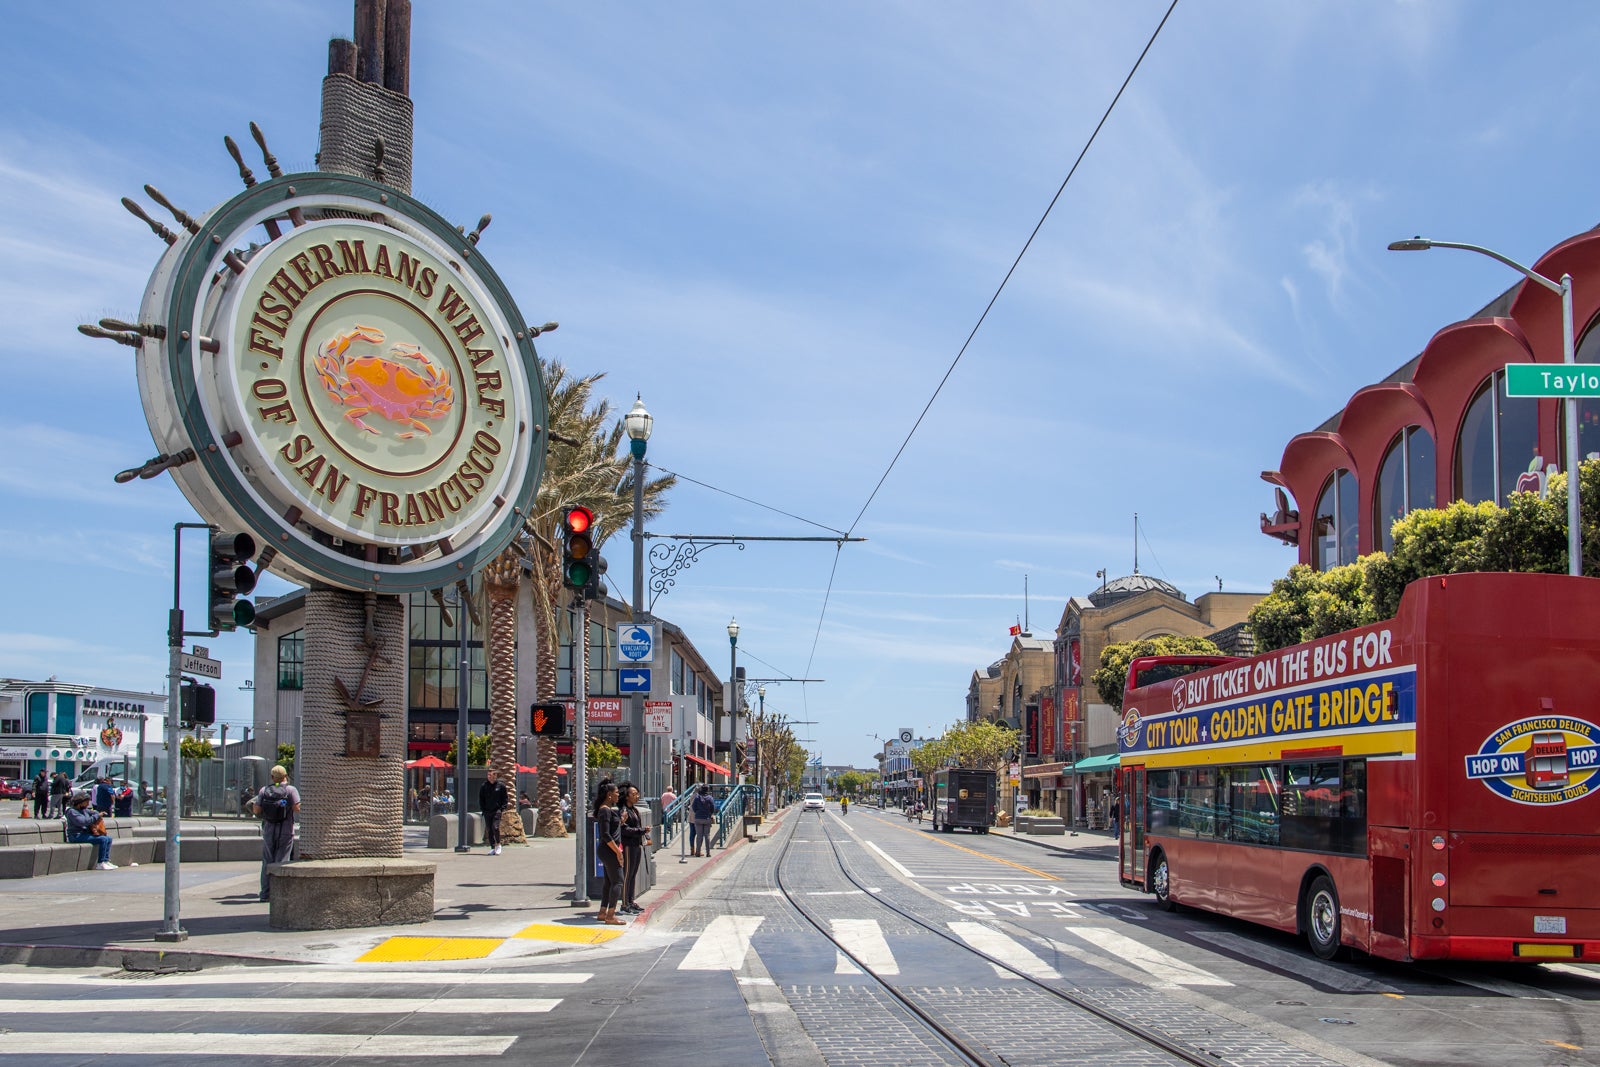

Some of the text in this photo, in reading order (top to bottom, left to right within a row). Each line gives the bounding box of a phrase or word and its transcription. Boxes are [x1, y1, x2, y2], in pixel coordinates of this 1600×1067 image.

[248, 238, 506, 420] FISHERMANS WHARF
[252, 377, 502, 527] OF SAN FRANCISCO
[184, 657, 218, 675] Jefferson
[1187, 629, 1393, 705] BUY TICKET ON THE BUS FOR
[593, 701, 620, 710] OPEN
[1146, 721, 1168, 749] CITY
[1169, 715, 1199, 746] TOUR
[1210, 703, 1267, 742] GOLDEN
[1271, 694, 1313, 734] GATE
[1319, 681, 1393, 728] BRIDGE
[1495, 718, 1592, 746] SAN FRANCISCO DELUXE
[1471, 749, 1598, 774] HOP ON HOP
[1535, 745, 1564, 755] DELUXE
[1511, 783, 1589, 803] SIGHTSEEING TOURS
[946, 882, 1078, 897] KEEP
